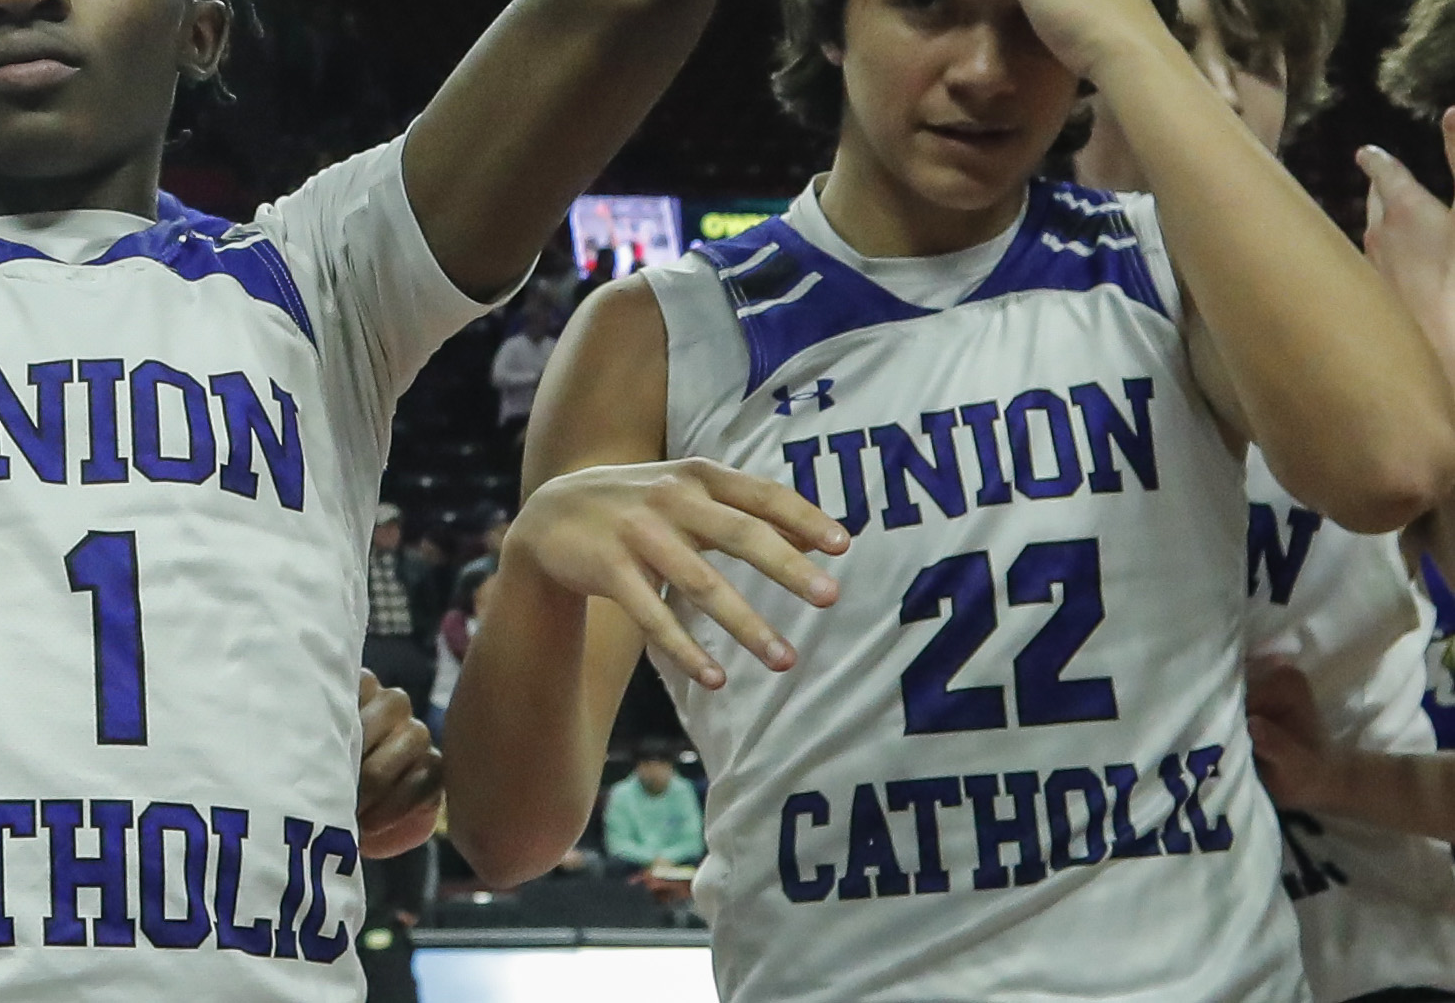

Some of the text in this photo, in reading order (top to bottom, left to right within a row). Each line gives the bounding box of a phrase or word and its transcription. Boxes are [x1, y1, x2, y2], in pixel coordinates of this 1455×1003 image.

[782, 376, 1160, 538] UNION
[63, 529, 148, 747] 1
[899, 537, 1120, 737] 22
[777, 744, 1234, 904] CATHOLIC
